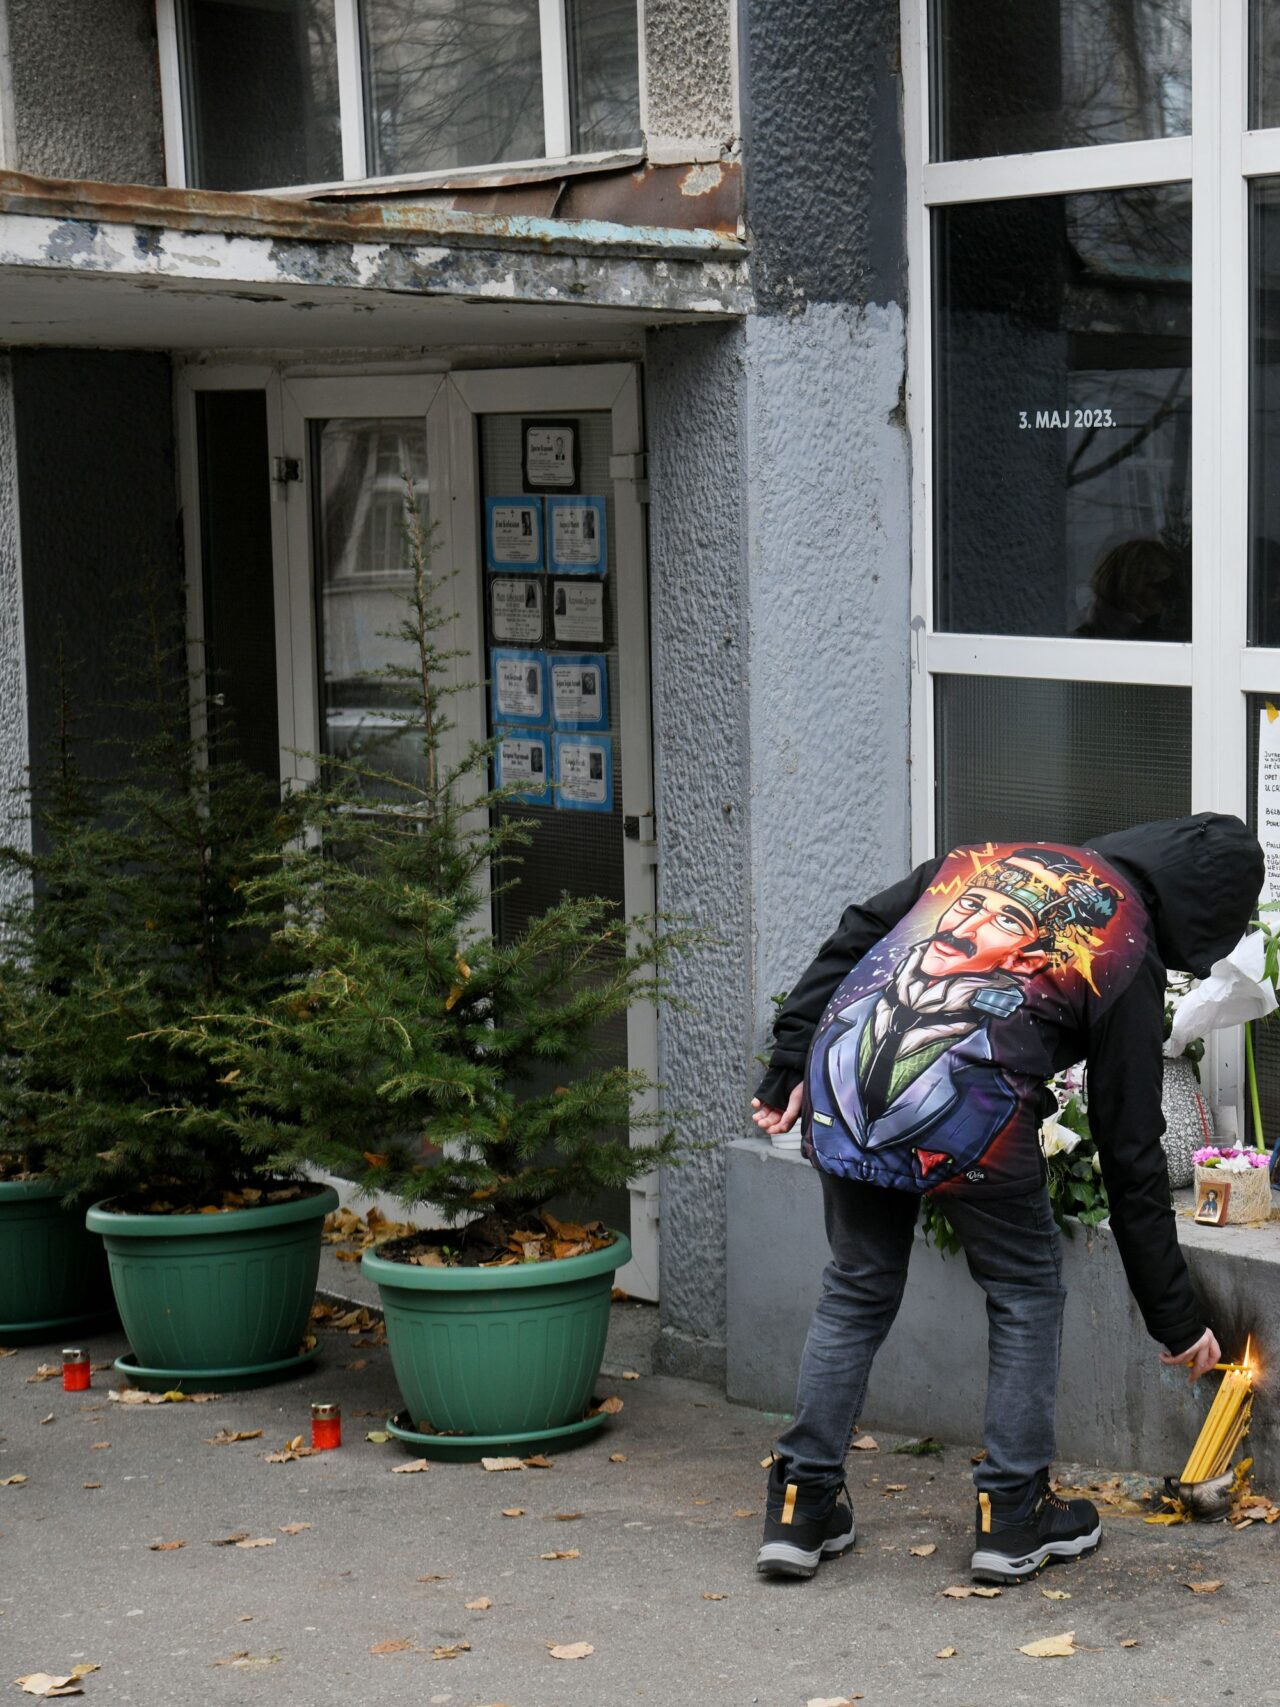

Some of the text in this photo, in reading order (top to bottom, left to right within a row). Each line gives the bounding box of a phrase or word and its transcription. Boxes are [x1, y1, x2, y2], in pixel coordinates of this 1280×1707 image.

[1018, 409, 1116, 429] 3. MAJ 2023.
